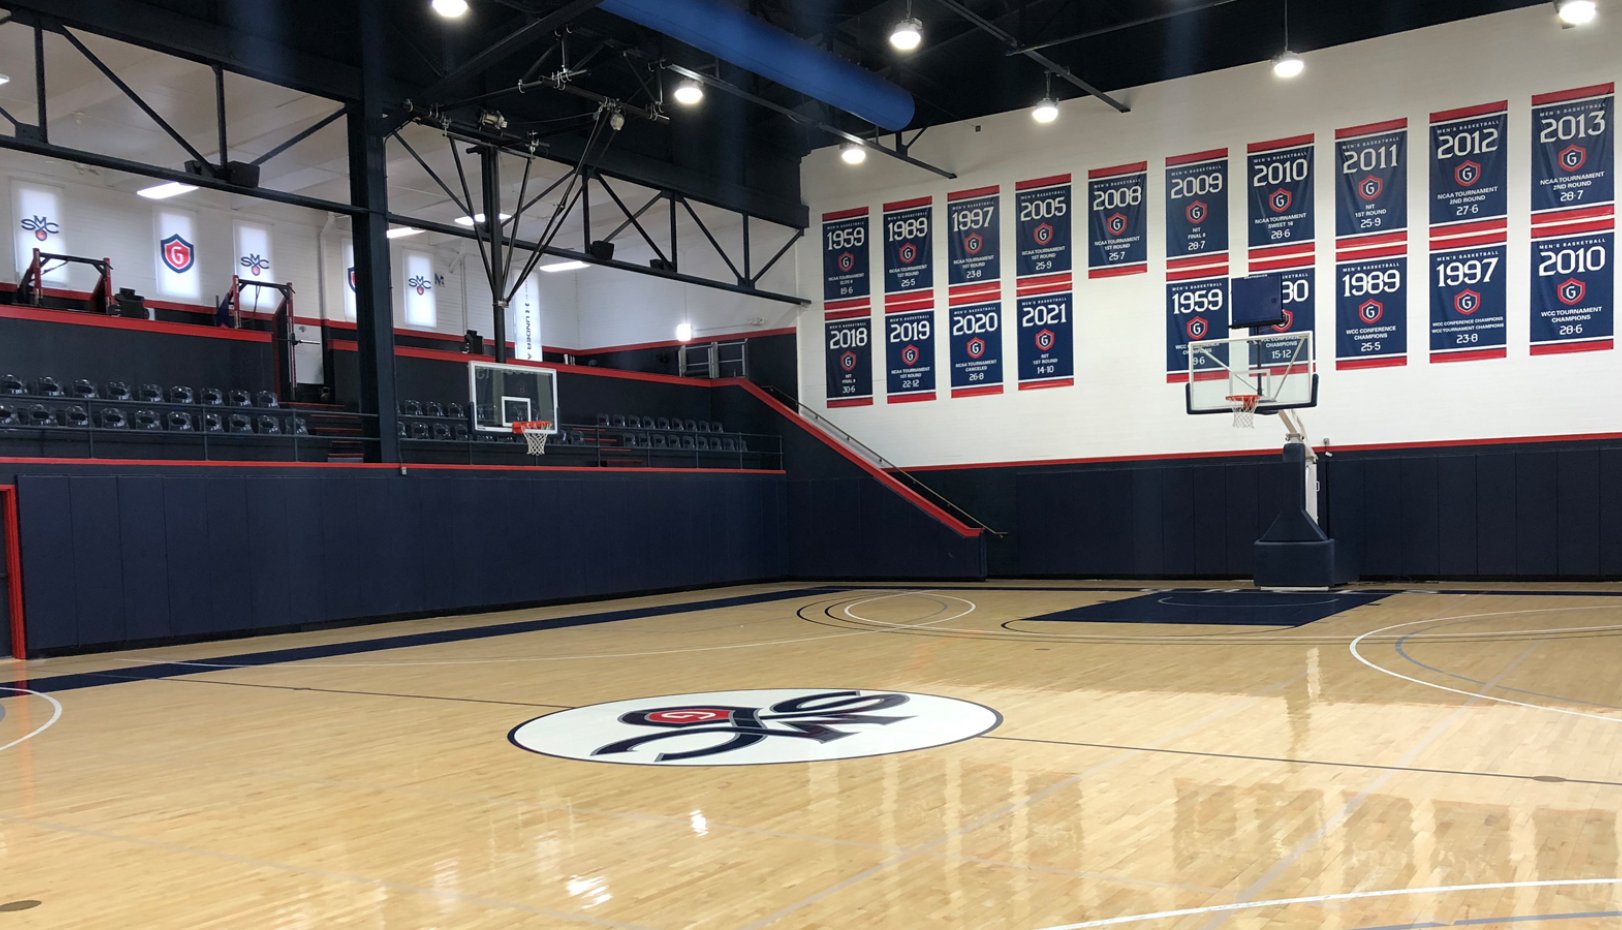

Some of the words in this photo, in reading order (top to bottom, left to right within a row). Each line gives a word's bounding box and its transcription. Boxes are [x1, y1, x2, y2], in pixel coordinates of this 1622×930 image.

[1564, 103, 1605, 113] BASKETBALL
[1459, 121, 1499, 130] BASKETBALL
[1540, 110, 1605, 143] 2013
[1438, 128, 1498, 159] 2012
[1343, 144, 1398, 174] 2011
[1567, 152, 1577, 165] G
[1254, 159, 1308, 186] 2010
[1463, 168, 1472, 180] G
[1559, 172, 1604, 183] TOURNAMENT
[1171, 173, 1222, 199] 2009
[1366, 183, 1375, 194] G
[1568, 180, 1591, 188] ROUND
[1455, 187, 1498, 197] TOURNAMENT
[1560, 190, 1583, 201] 28-7
[1093, 186, 1141, 210] 2008
[1276, 195, 1284, 207] G
[1463, 195, 1485, 203] ROUND
[1021, 197, 1066, 221] 2005
[1192, 208, 1200, 218] G
[1457, 204, 1478, 215] 27-6
[952, 207, 994, 232] 1997
[1113, 220, 1120, 230] G
[1361, 218, 1381, 228] 25-9
[888, 218, 927, 241] 1989
[1040, 229, 1046, 240] G
[1271, 229, 1290, 239] 28-6
[827, 227, 864, 250] 1959
[1563, 238, 1605, 247] BASKETBALL
[970, 240, 977, 249] G
[171, 246, 183, 264] G
[905, 249, 911, 258] G
[1459, 251, 1499, 259] BASKETBALL
[843, 257, 849, 267] G
[1539, 246, 1605, 276] 2010
[1436, 257, 1499, 286] 1997
[1343, 270, 1400, 297] 1989
[1566, 286, 1576, 299] G
[1172, 289, 1222, 314] 1959
[1462, 297, 1472, 308] G
[1023, 304, 1066, 327] 2021
[1366, 306, 1375, 318] G
[1557, 307, 1602, 315] TOURNAMENT
[953, 313, 998, 336] 2020
[1552, 315, 1591, 323] CHAMPIONS
[890, 321, 930, 342] 2019
[1193, 323, 1200, 334] G
[1560, 324, 1582, 335] 28-6
[830, 328, 867, 349] 2018
[1041, 335, 1048, 345] G
[1457, 334, 1478, 343] 23-8
[972, 344, 978, 353] G
[1361, 342, 1381, 351] 25-5
[907, 351, 913, 360] G
[1272, 350, 1291, 359] 15-12
[845, 357, 851, 366] G
